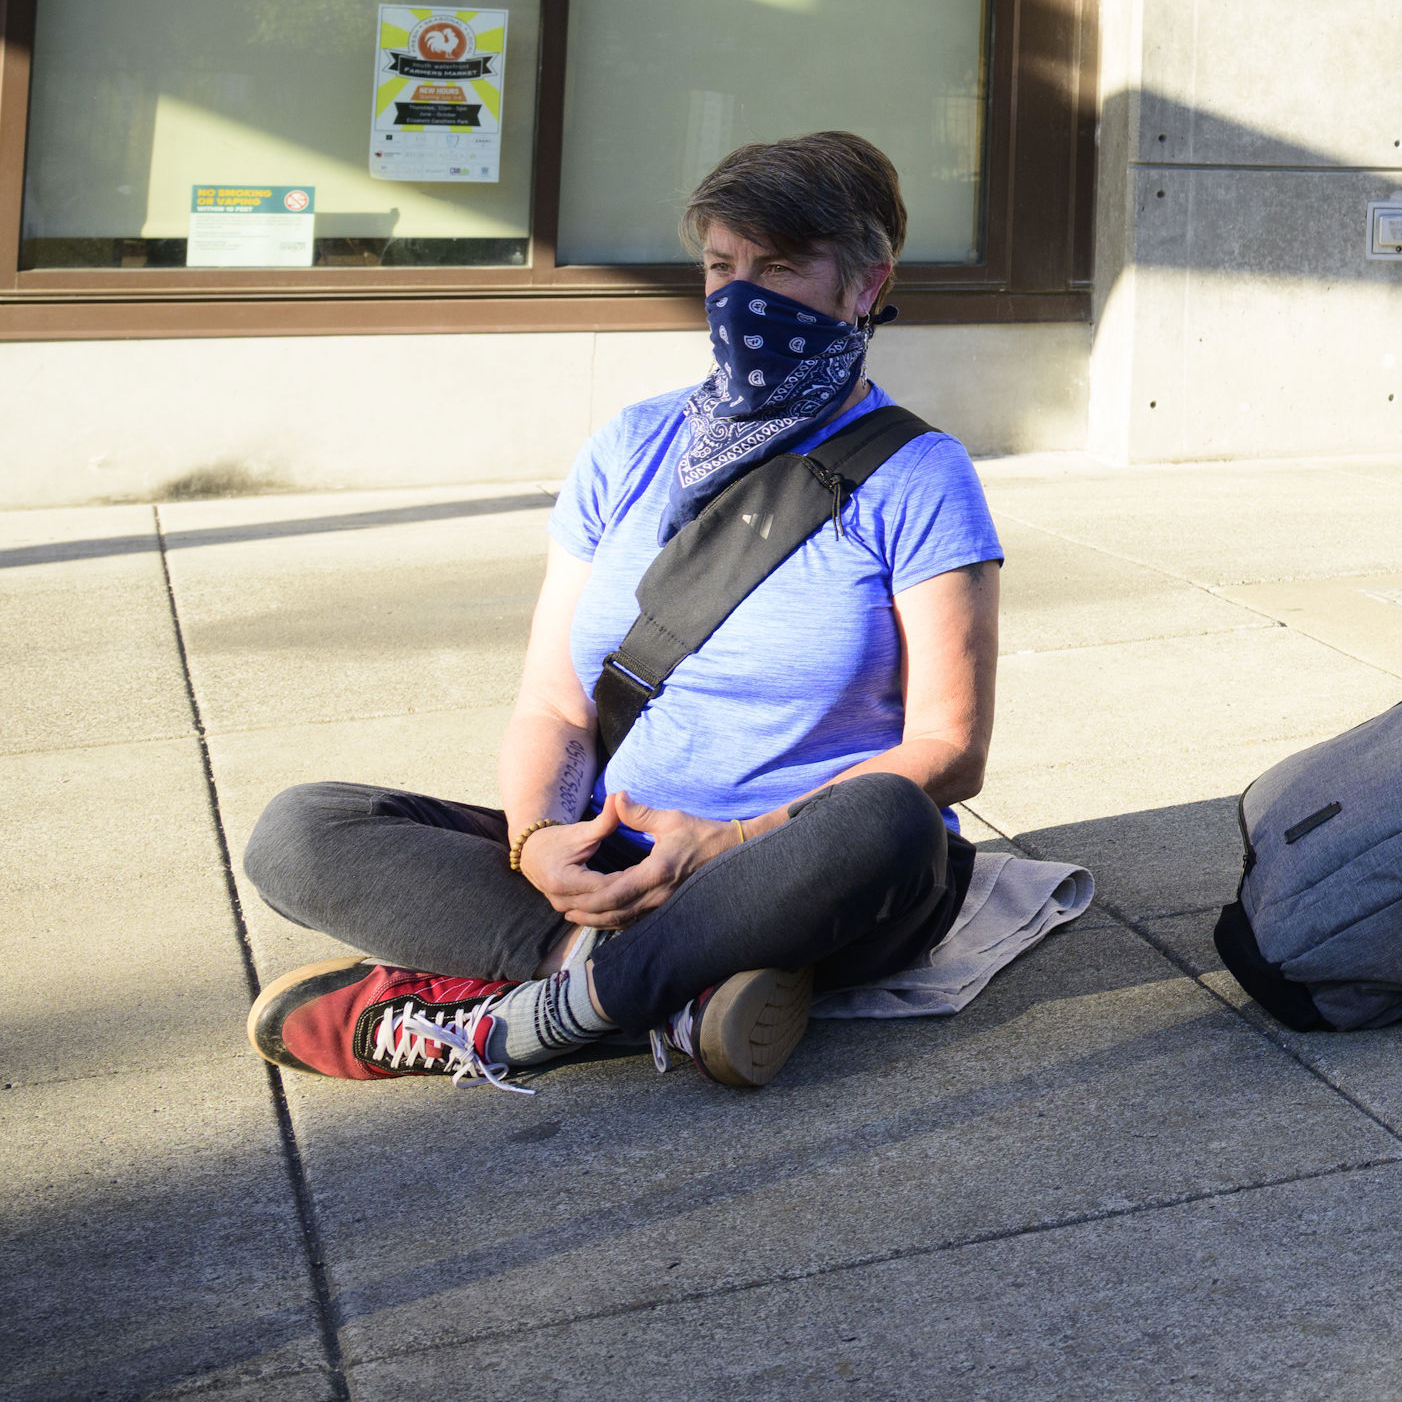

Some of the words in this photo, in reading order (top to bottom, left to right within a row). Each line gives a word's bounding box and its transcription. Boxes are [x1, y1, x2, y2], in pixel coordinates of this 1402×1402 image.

[404, 67, 443, 76] FARMERS
[419, 86, 435, 94] NEW
[436, 87, 459, 95] HOURS
[197, 189, 216, 197] NO
[217, 189, 272, 198] SMOKING
[216, 198, 262, 206] VAPING
